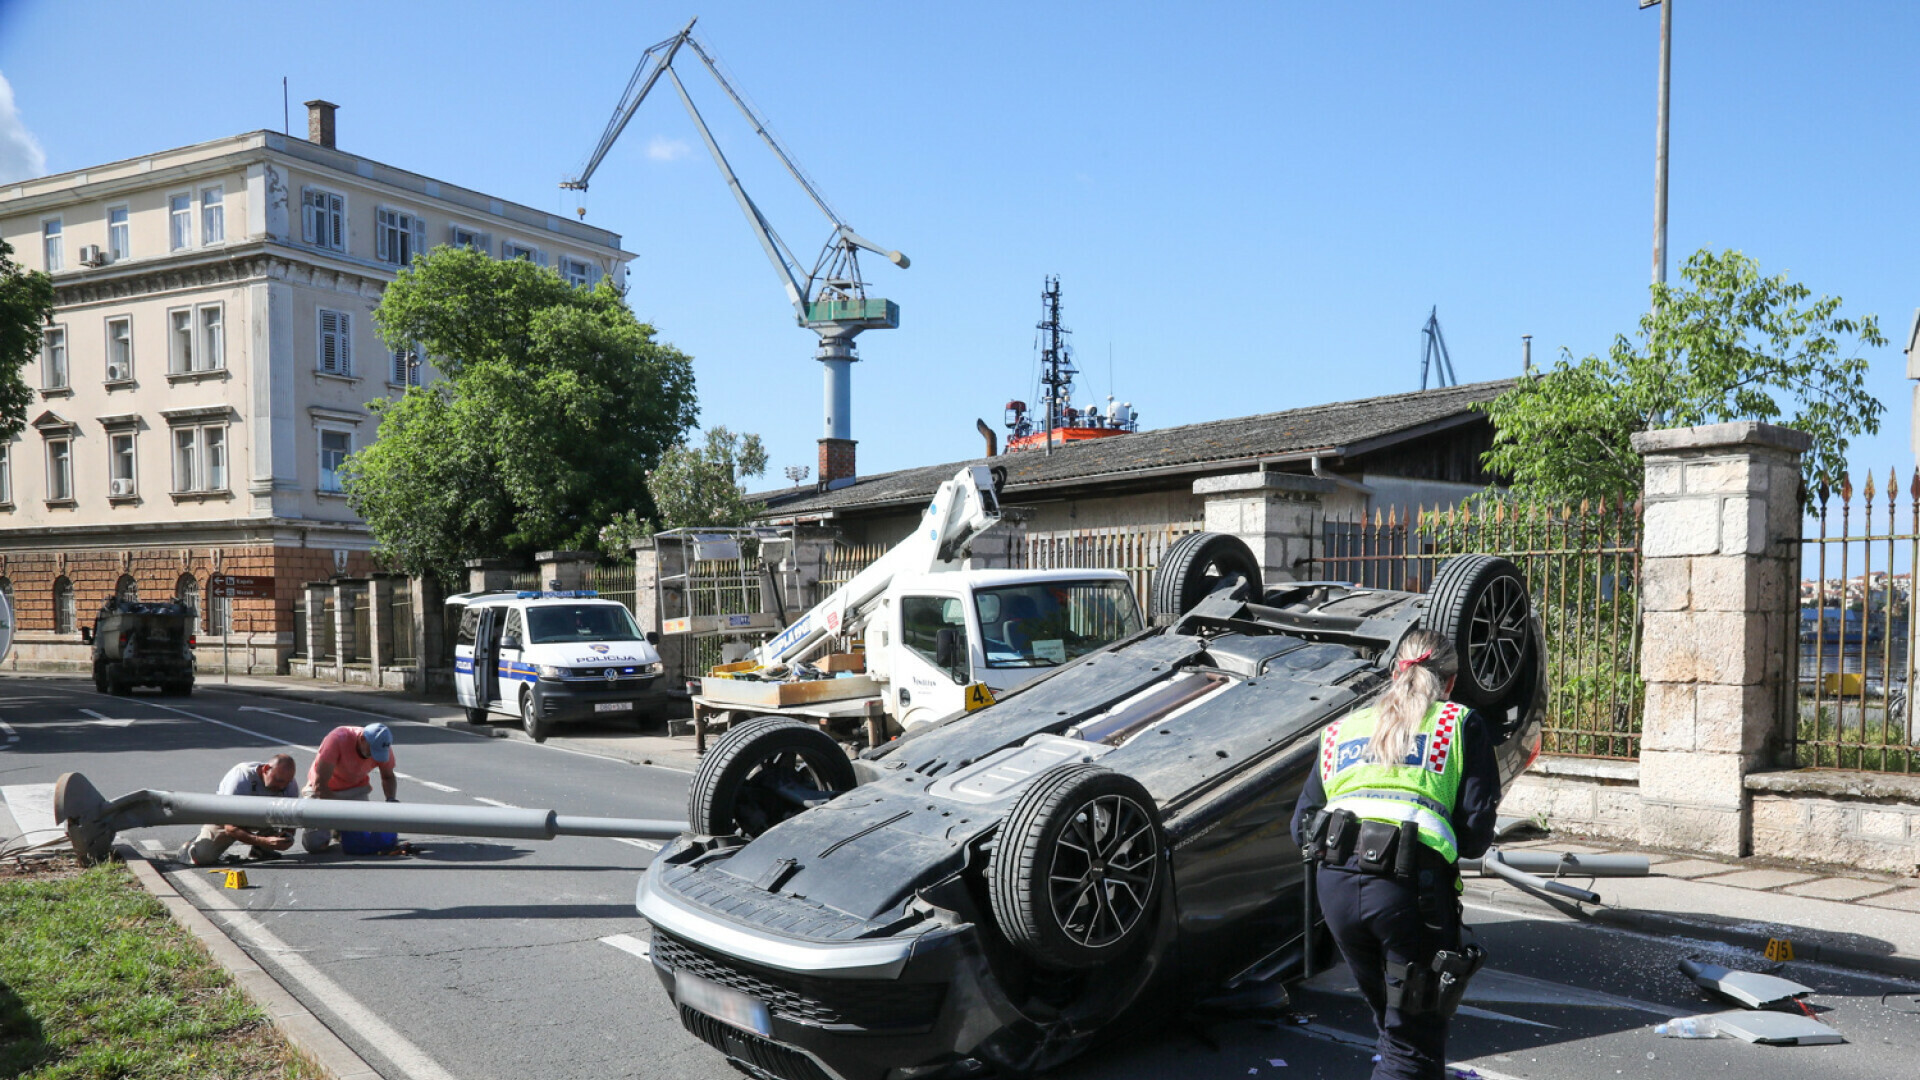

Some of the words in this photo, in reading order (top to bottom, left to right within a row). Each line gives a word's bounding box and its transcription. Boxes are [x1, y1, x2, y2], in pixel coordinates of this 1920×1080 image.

[576, 655, 637, 664] POLICIJA
[973, 685, 984, 704] 4
[1768, 941, 1776, 957] 5
[1781, 941, 1789, 959] 5
